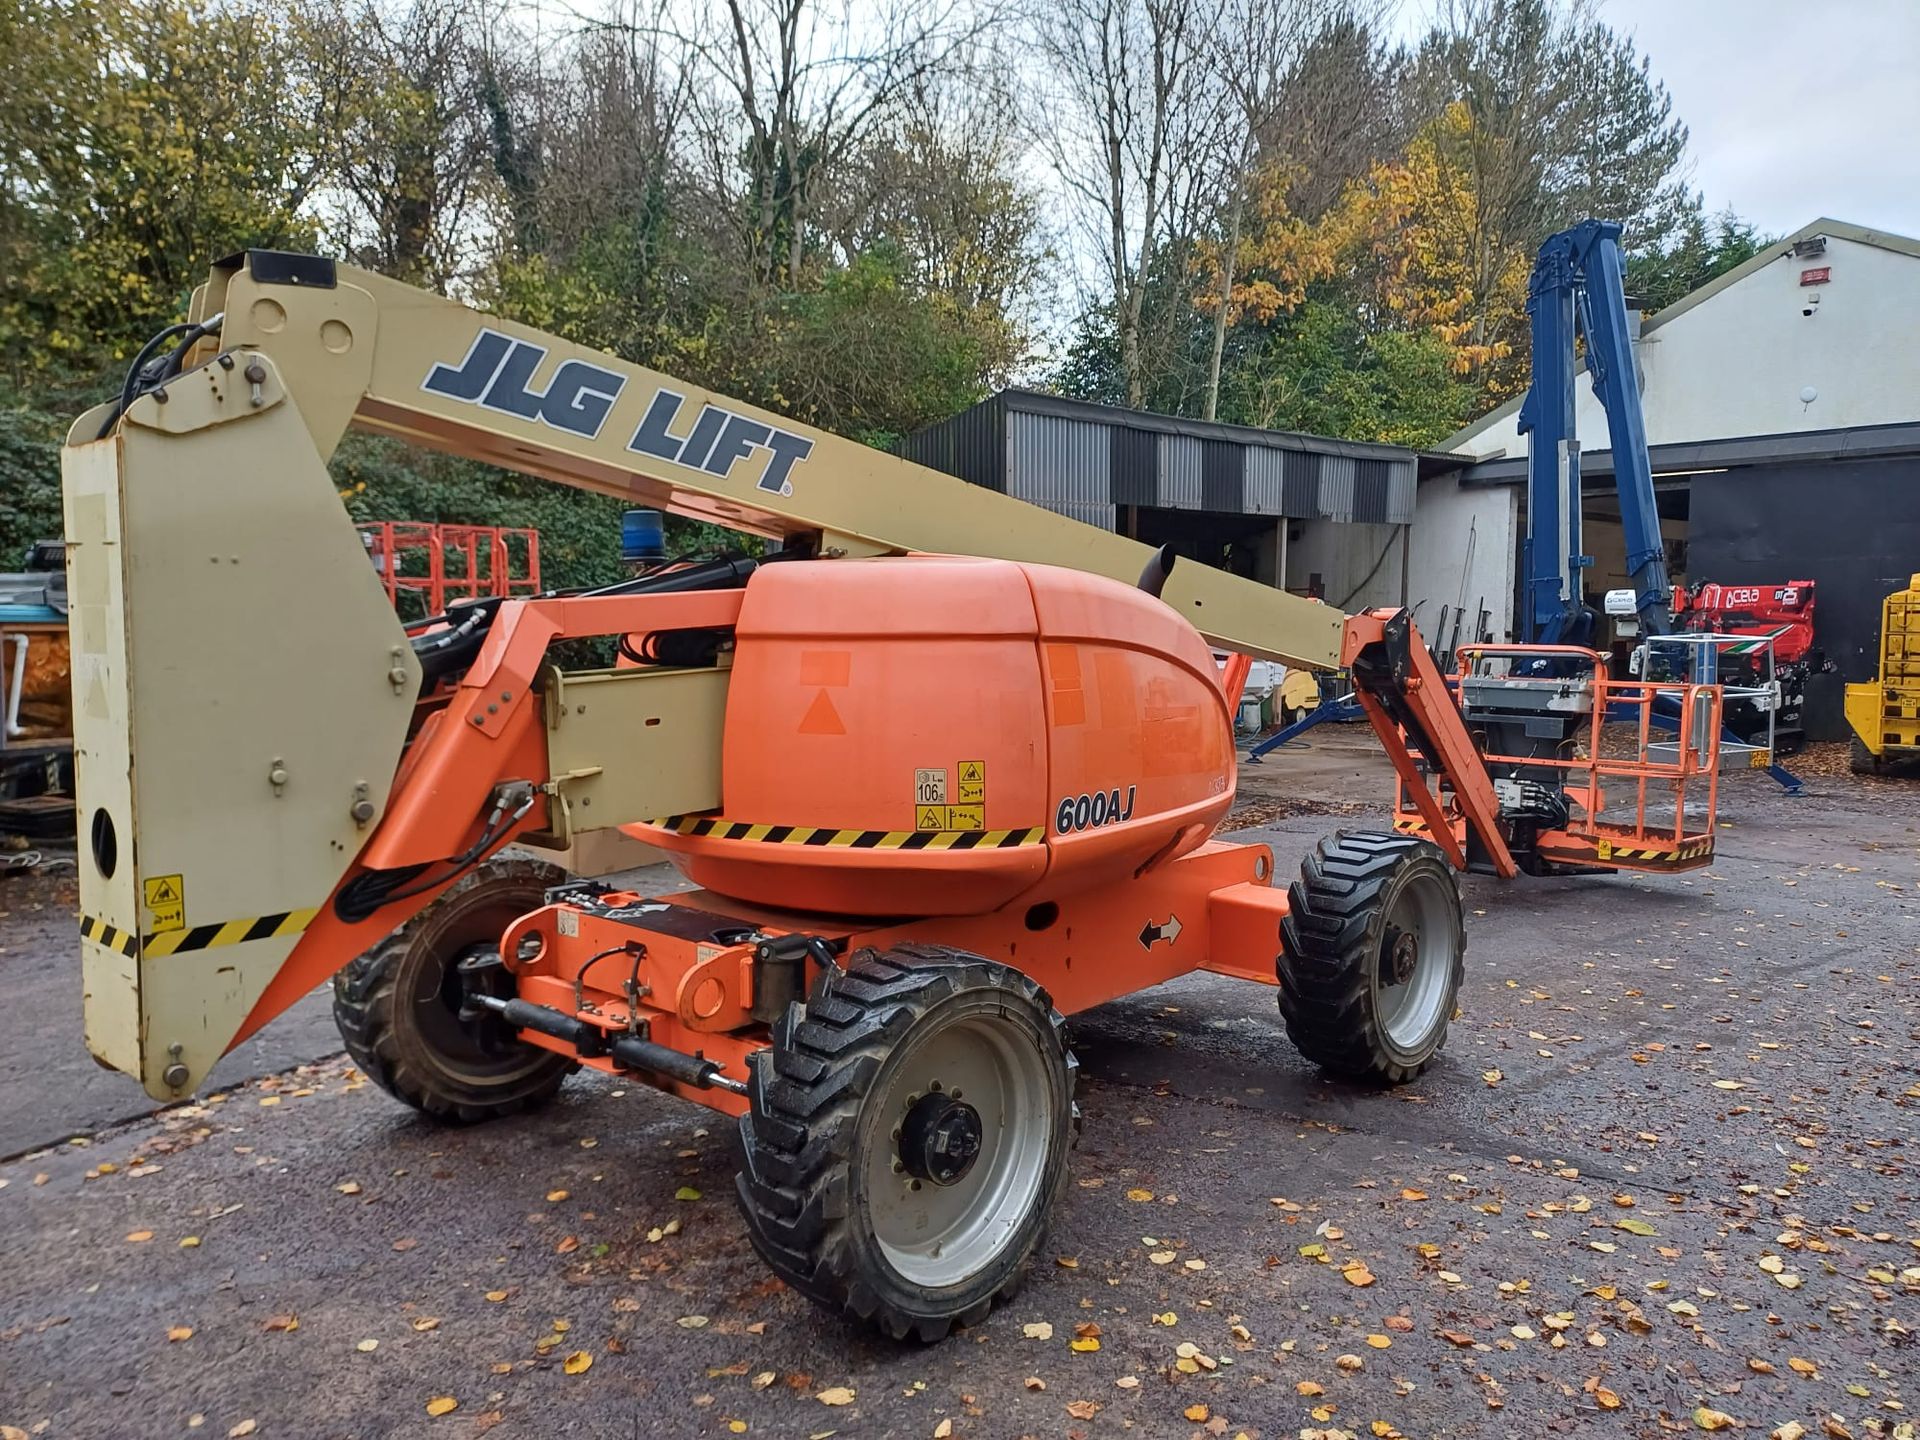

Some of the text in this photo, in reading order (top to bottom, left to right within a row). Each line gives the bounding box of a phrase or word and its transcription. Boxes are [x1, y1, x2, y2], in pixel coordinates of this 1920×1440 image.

[419, 326, 816, 495] JLG LIFT
[918, 783, 939, 802] 106
[1055, 784, 1138, 837] 600AJ
